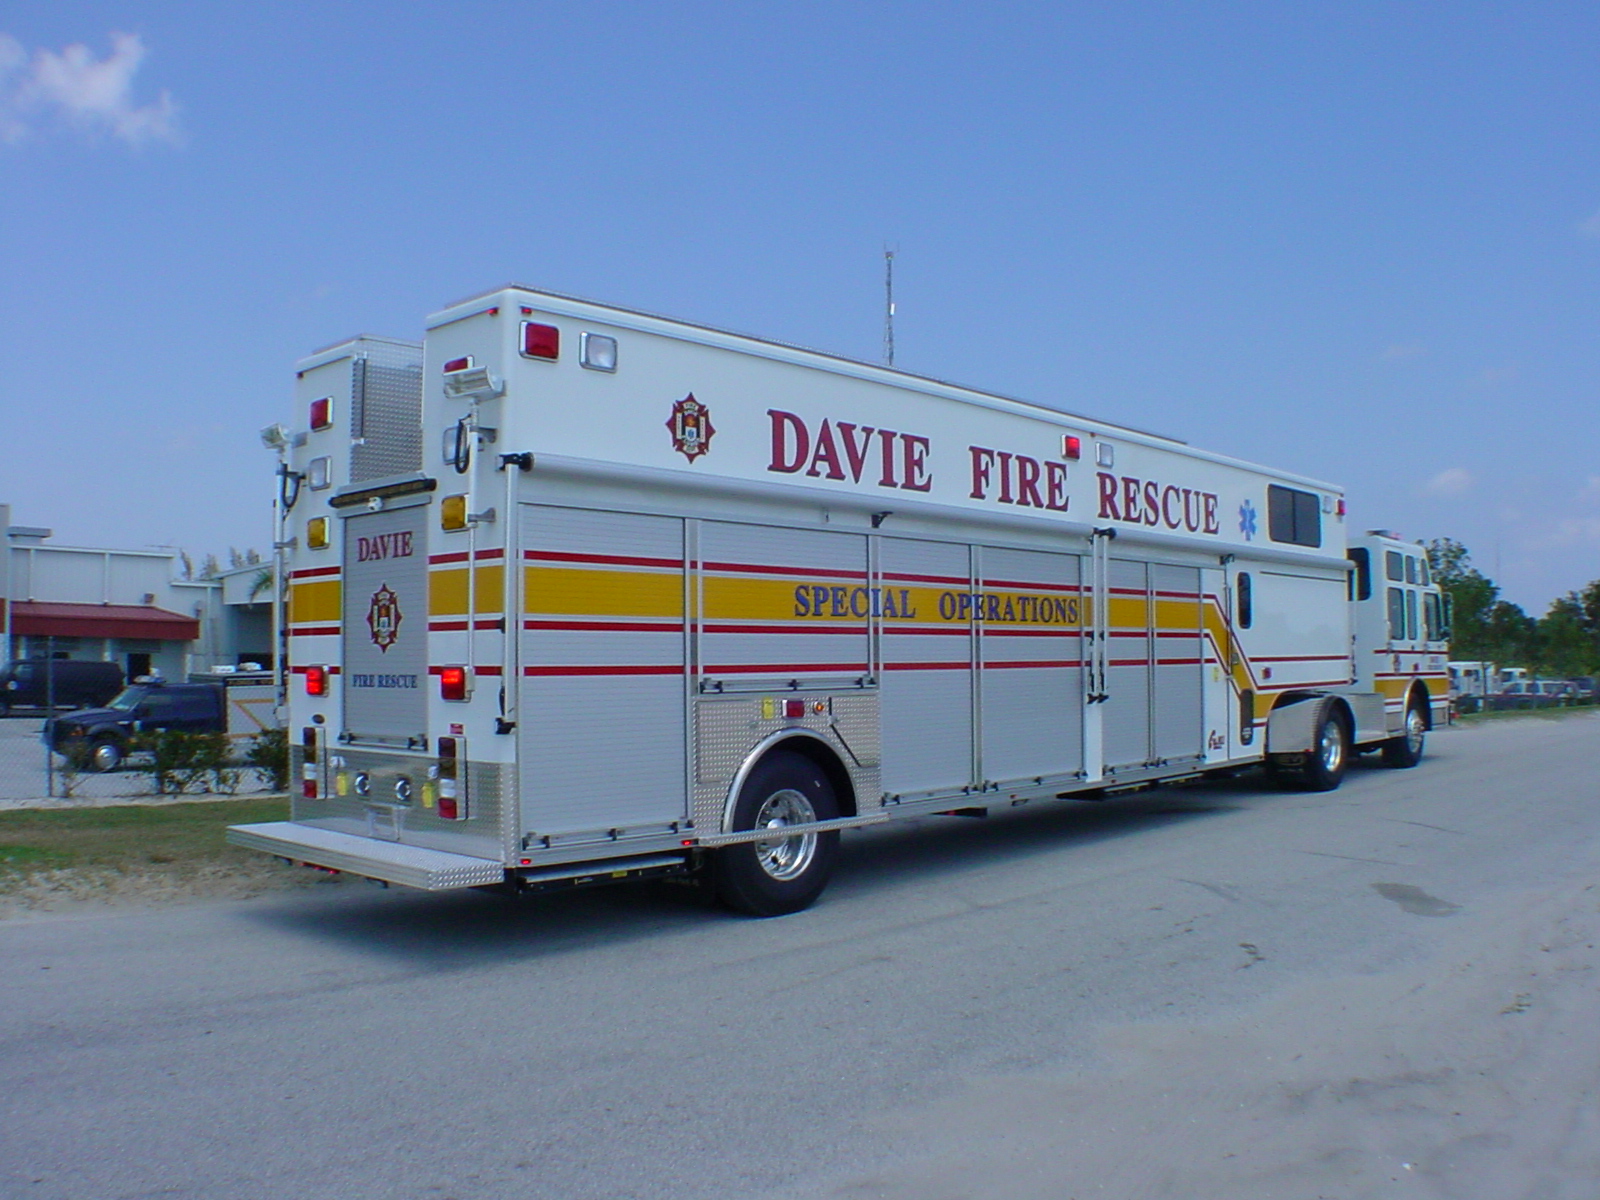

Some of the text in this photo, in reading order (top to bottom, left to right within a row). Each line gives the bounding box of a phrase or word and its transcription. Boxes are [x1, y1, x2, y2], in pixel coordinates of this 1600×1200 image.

[767, 408, 1220, 535] DAVIE FIRE RESCUE
[357, 531, 413, 562] DAVIE
[794, 585, 1079, 623] SPECIAL OPERATIONS
[352, 674, 418, 689] FIRE RESCUE
